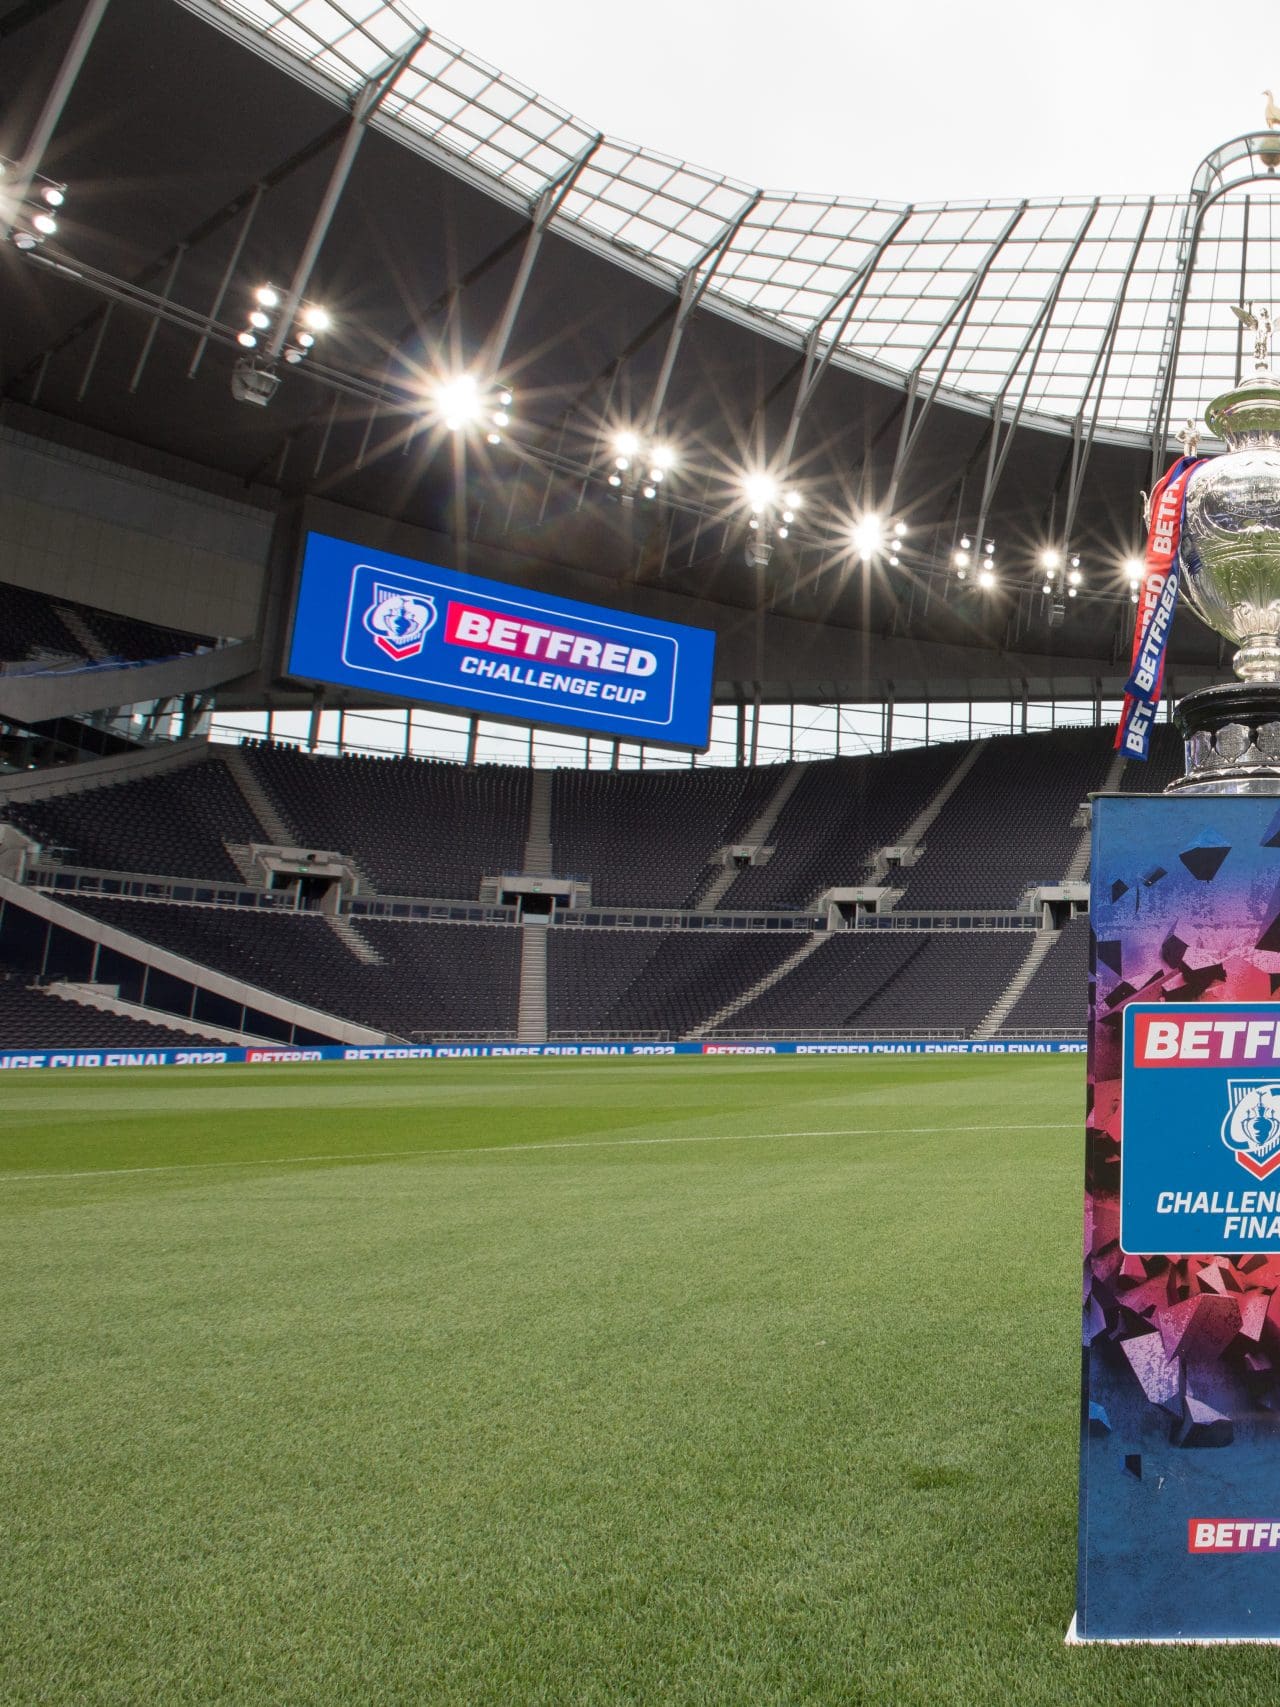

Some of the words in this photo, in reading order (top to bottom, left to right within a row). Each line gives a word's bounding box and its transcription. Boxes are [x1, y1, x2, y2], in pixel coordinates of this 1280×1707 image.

[1153, 474, 1182, 555] BETF
[455, 610, 658, 677] BETFRED
[1134, 574, 1179, 694] BETFRED
[460, 656, 600, 698] CHALLENGE
[601, 683, 647, 705] CUP
